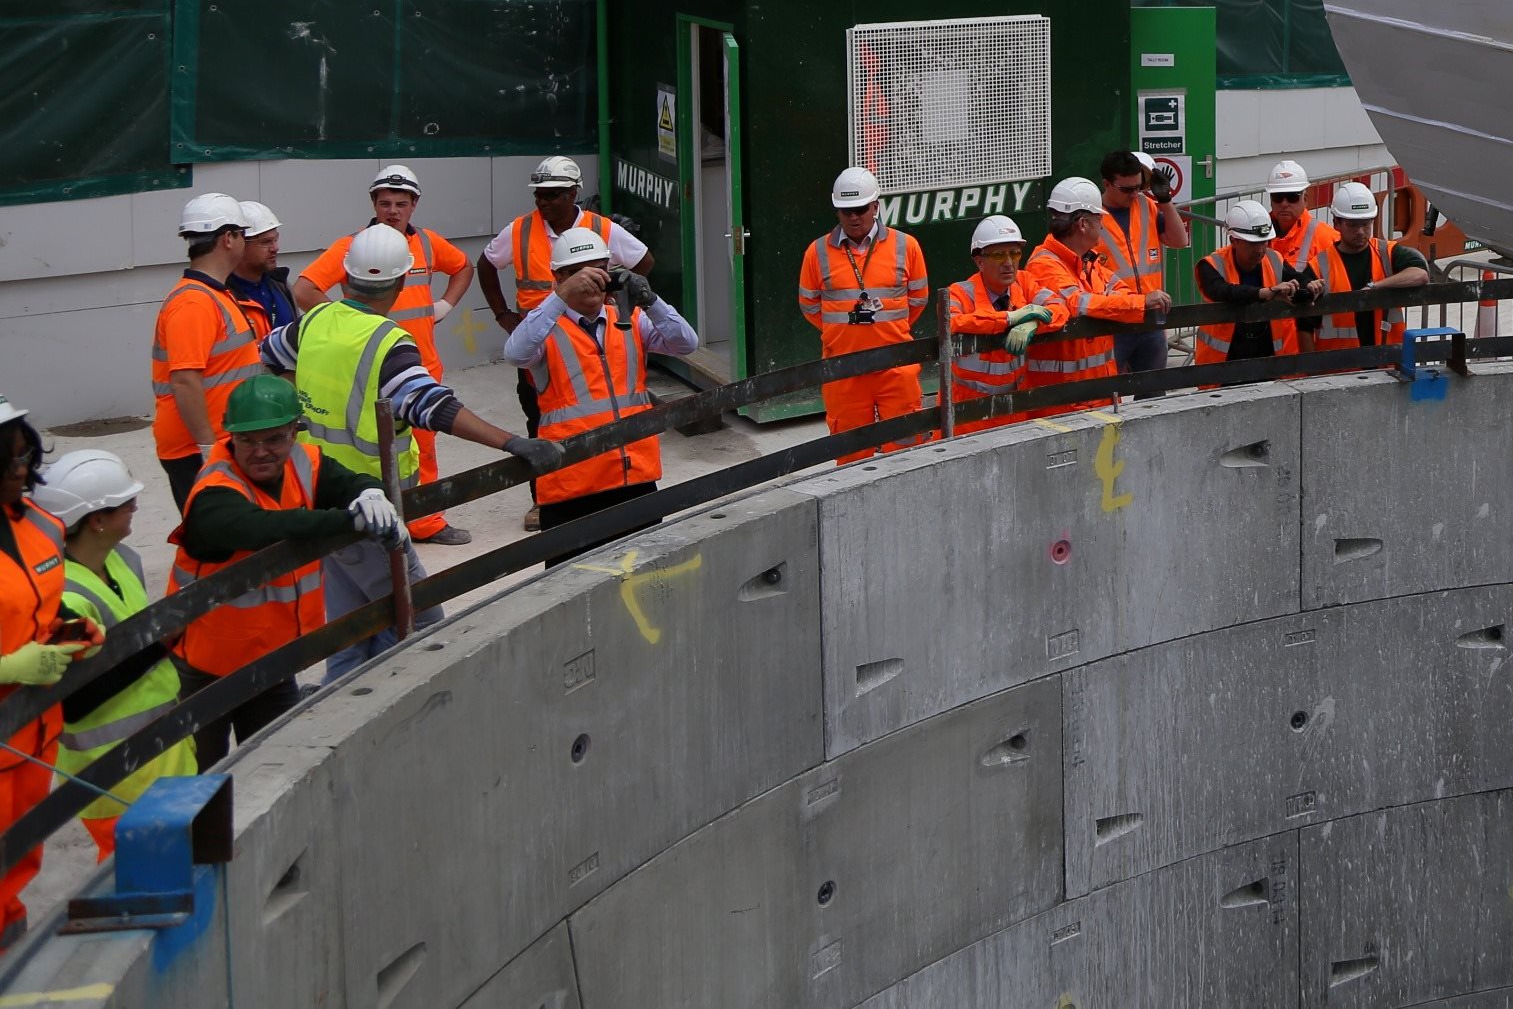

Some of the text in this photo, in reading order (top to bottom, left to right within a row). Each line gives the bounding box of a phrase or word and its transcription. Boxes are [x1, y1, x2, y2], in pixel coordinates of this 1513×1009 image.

[1143, 141, 1182, 150] Stretcher
[617, 160, 674, 208] MURPHY
[878, 181, 1032, 226] MURPHY
